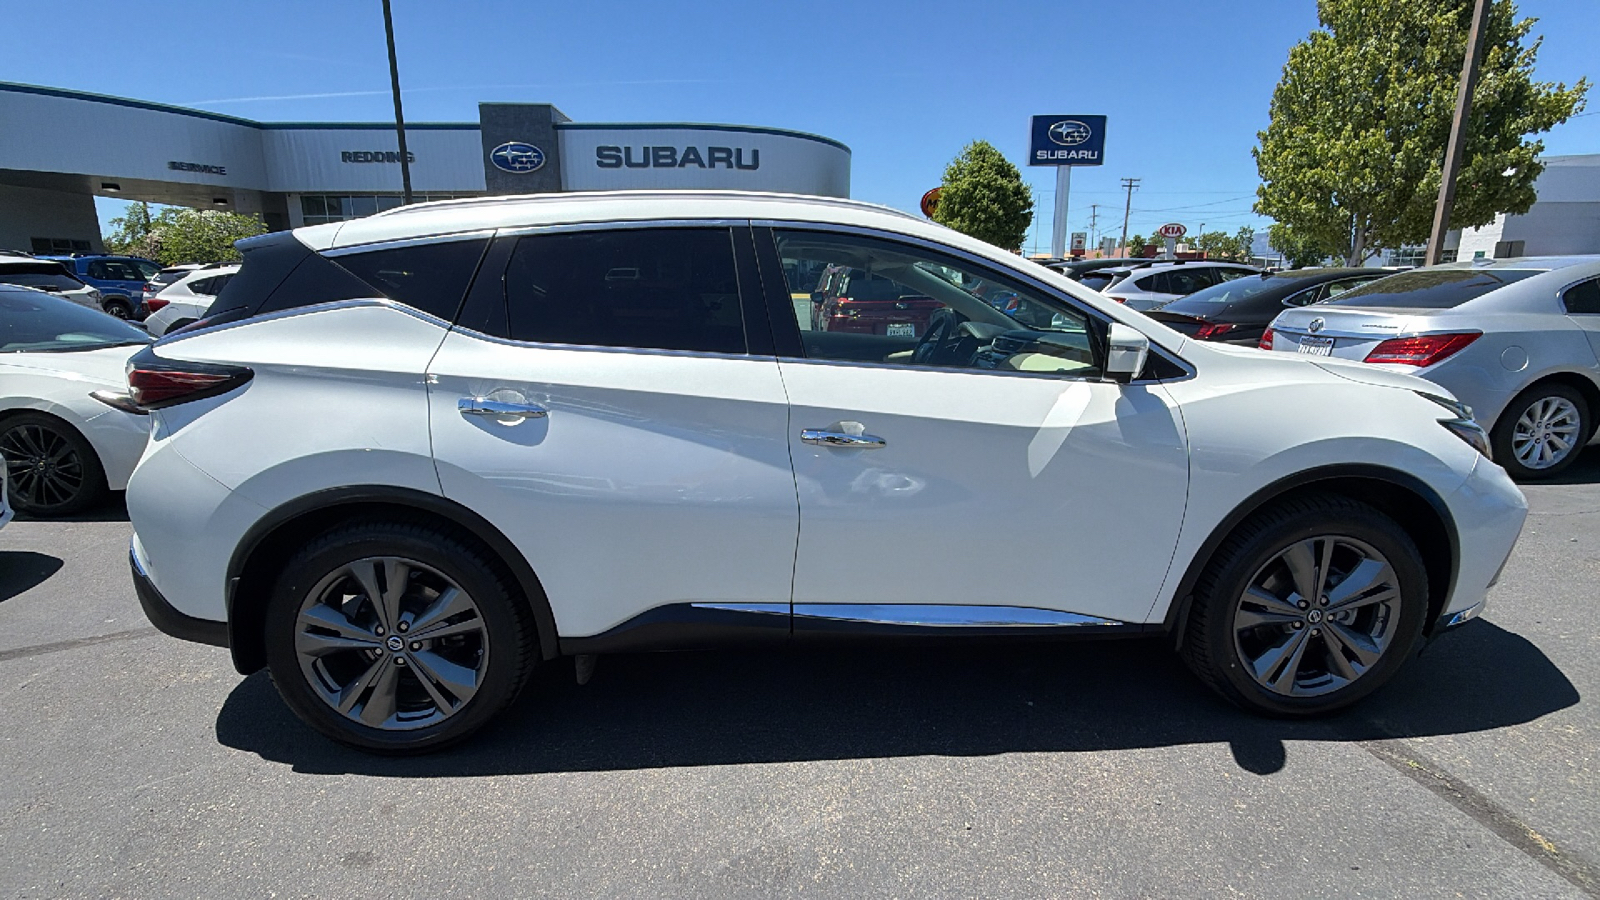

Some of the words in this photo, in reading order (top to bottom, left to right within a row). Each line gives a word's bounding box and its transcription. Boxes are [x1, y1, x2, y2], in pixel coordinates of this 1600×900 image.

[341, 151, 415, 163] REDDING
[596, 145, 760, 170] SUBARU
[1036, 150, 1098, 159] SUBARU
[1164, 226, 1182, 235] KIA
